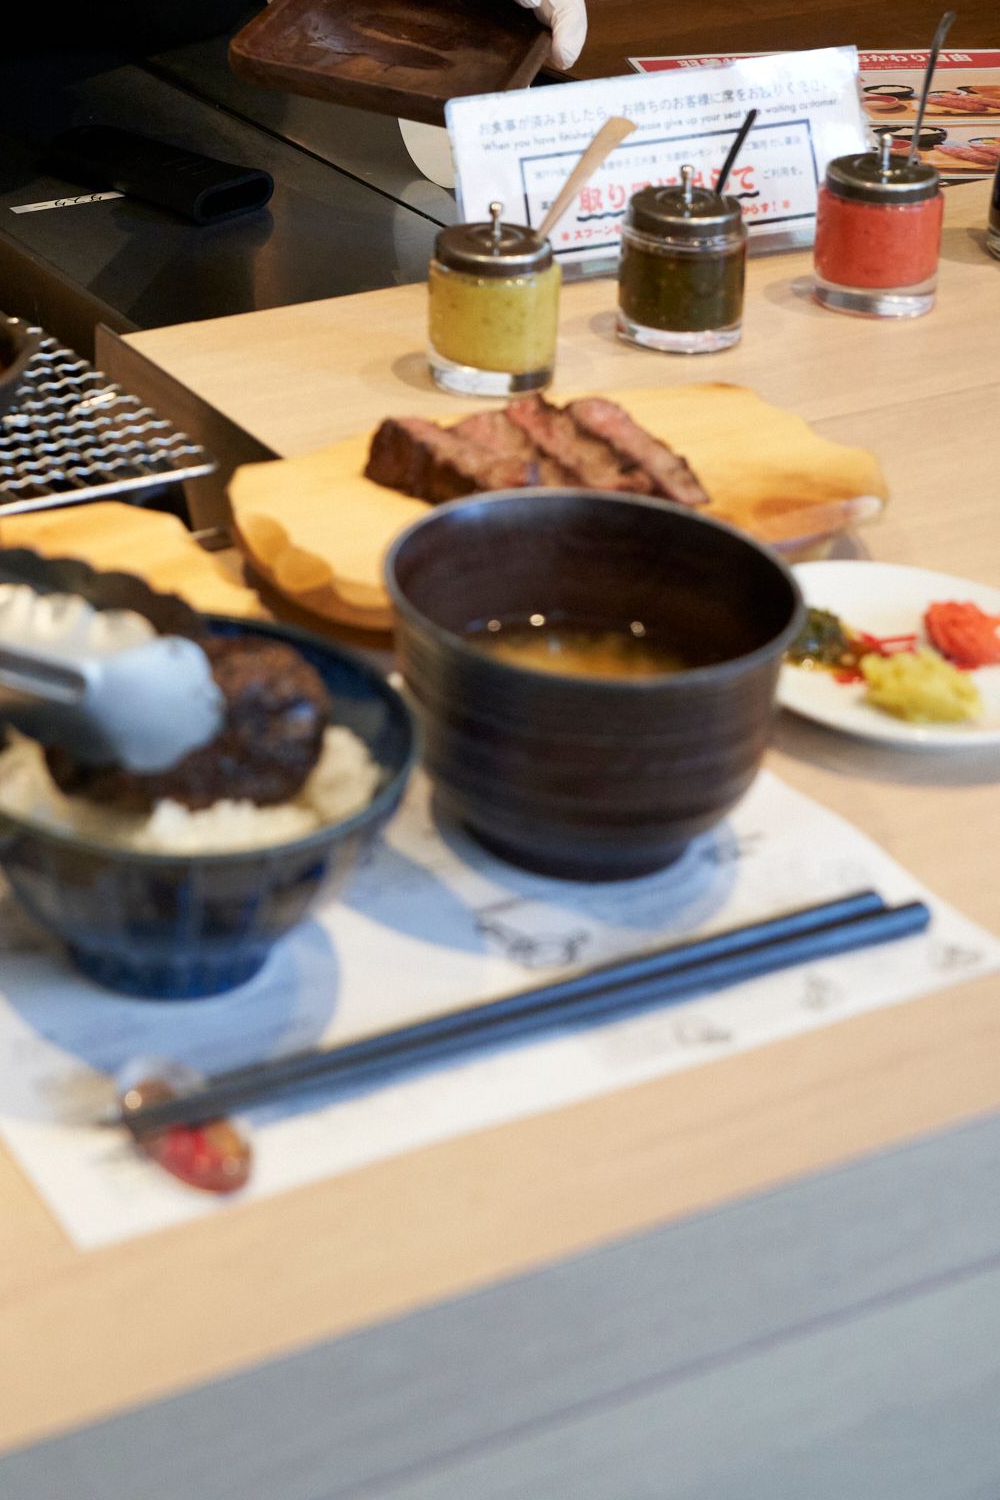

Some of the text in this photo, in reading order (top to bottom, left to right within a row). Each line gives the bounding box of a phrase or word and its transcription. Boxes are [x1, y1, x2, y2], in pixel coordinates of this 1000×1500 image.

[513, 139, 531, 150] you
[533, 133, 556, 145] have
[634, 120, 662, 133] lease
[664, 117, 683, 130] give
[701, 114, 721, 126] your
[723, 110, 742, 120] seat
[765, 102, 796, 115] waiting
